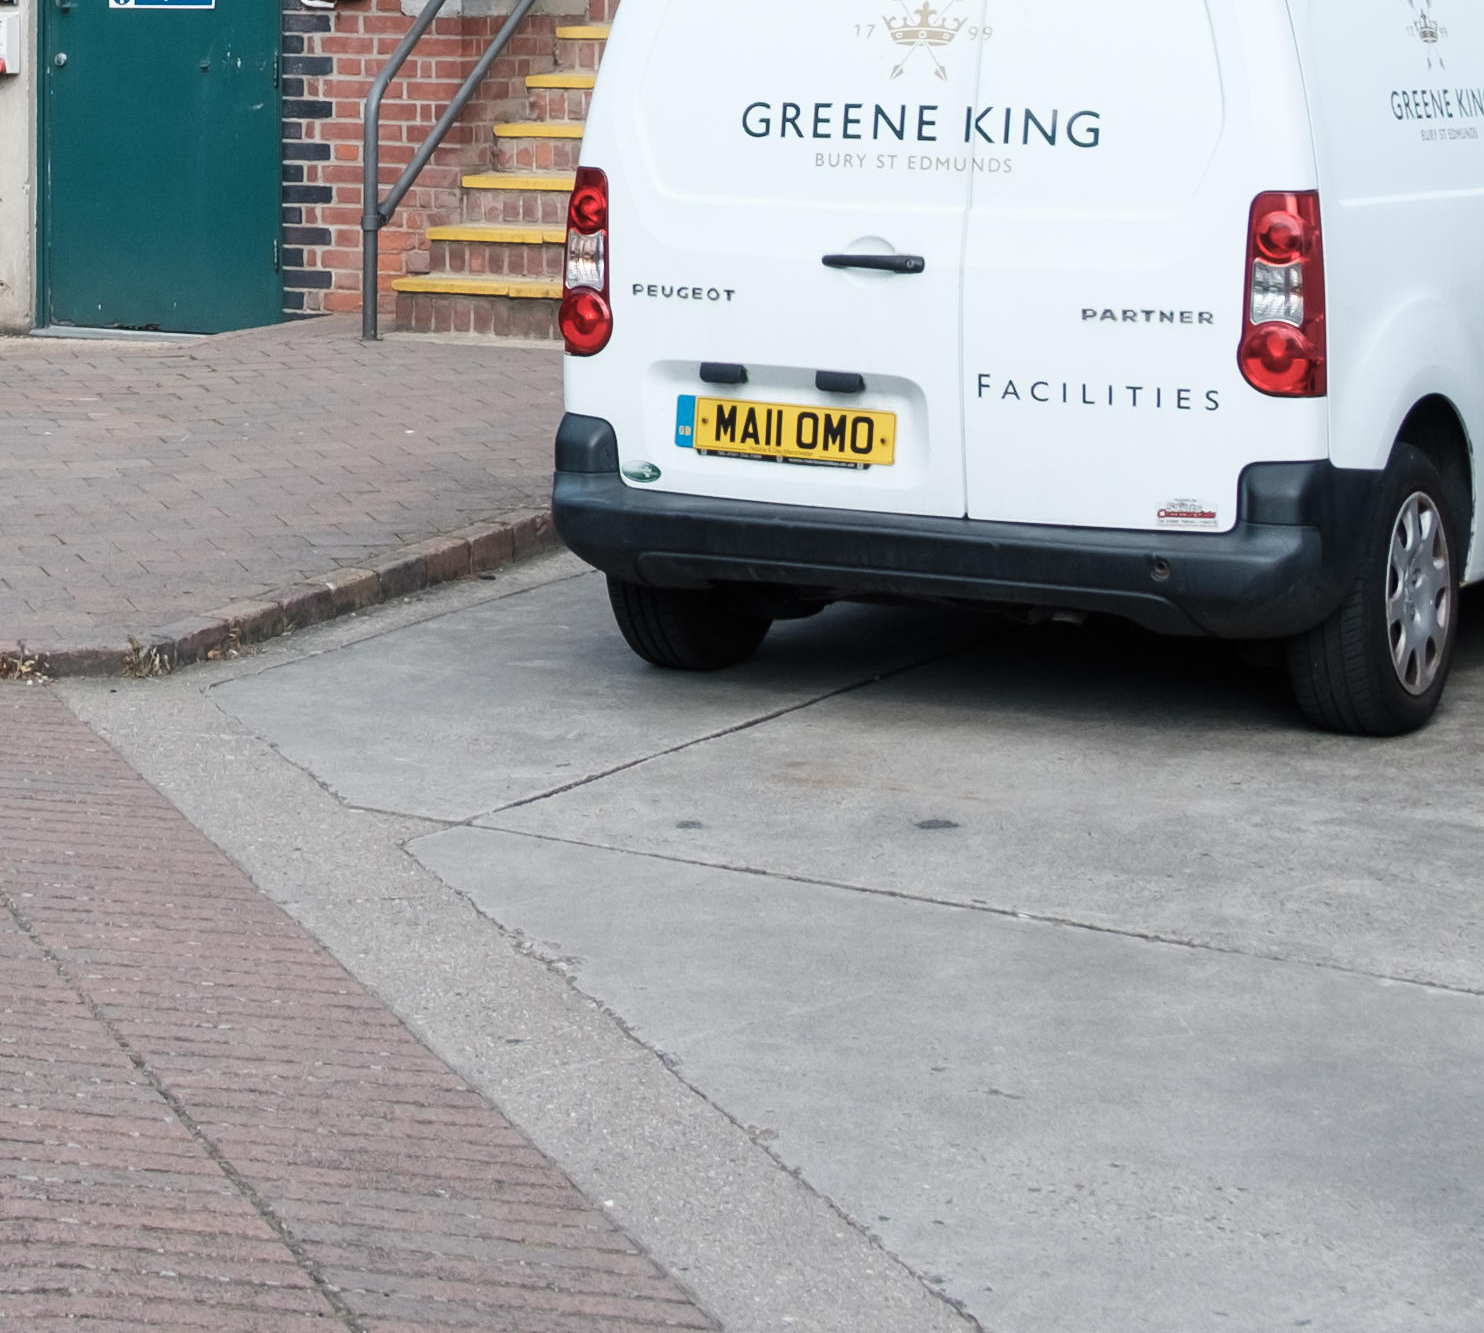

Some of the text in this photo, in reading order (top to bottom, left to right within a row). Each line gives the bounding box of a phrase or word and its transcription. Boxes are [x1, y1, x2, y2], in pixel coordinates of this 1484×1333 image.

[853, 23, 993, 41] 17 99
[1390, 89, 1454, 121] GREENE
[741, 101, 1101, 148] GREENE KING
[815, 152, 1014, 174] BURY ST EDMUNDS
[632, 284, 735, 303] PEUGEOT
[1080, 308, 1214, 326] PARTNER
[978, 373, 1221, 412] FACILITIES
[715, 404, 875, 455] MA11 OMO
